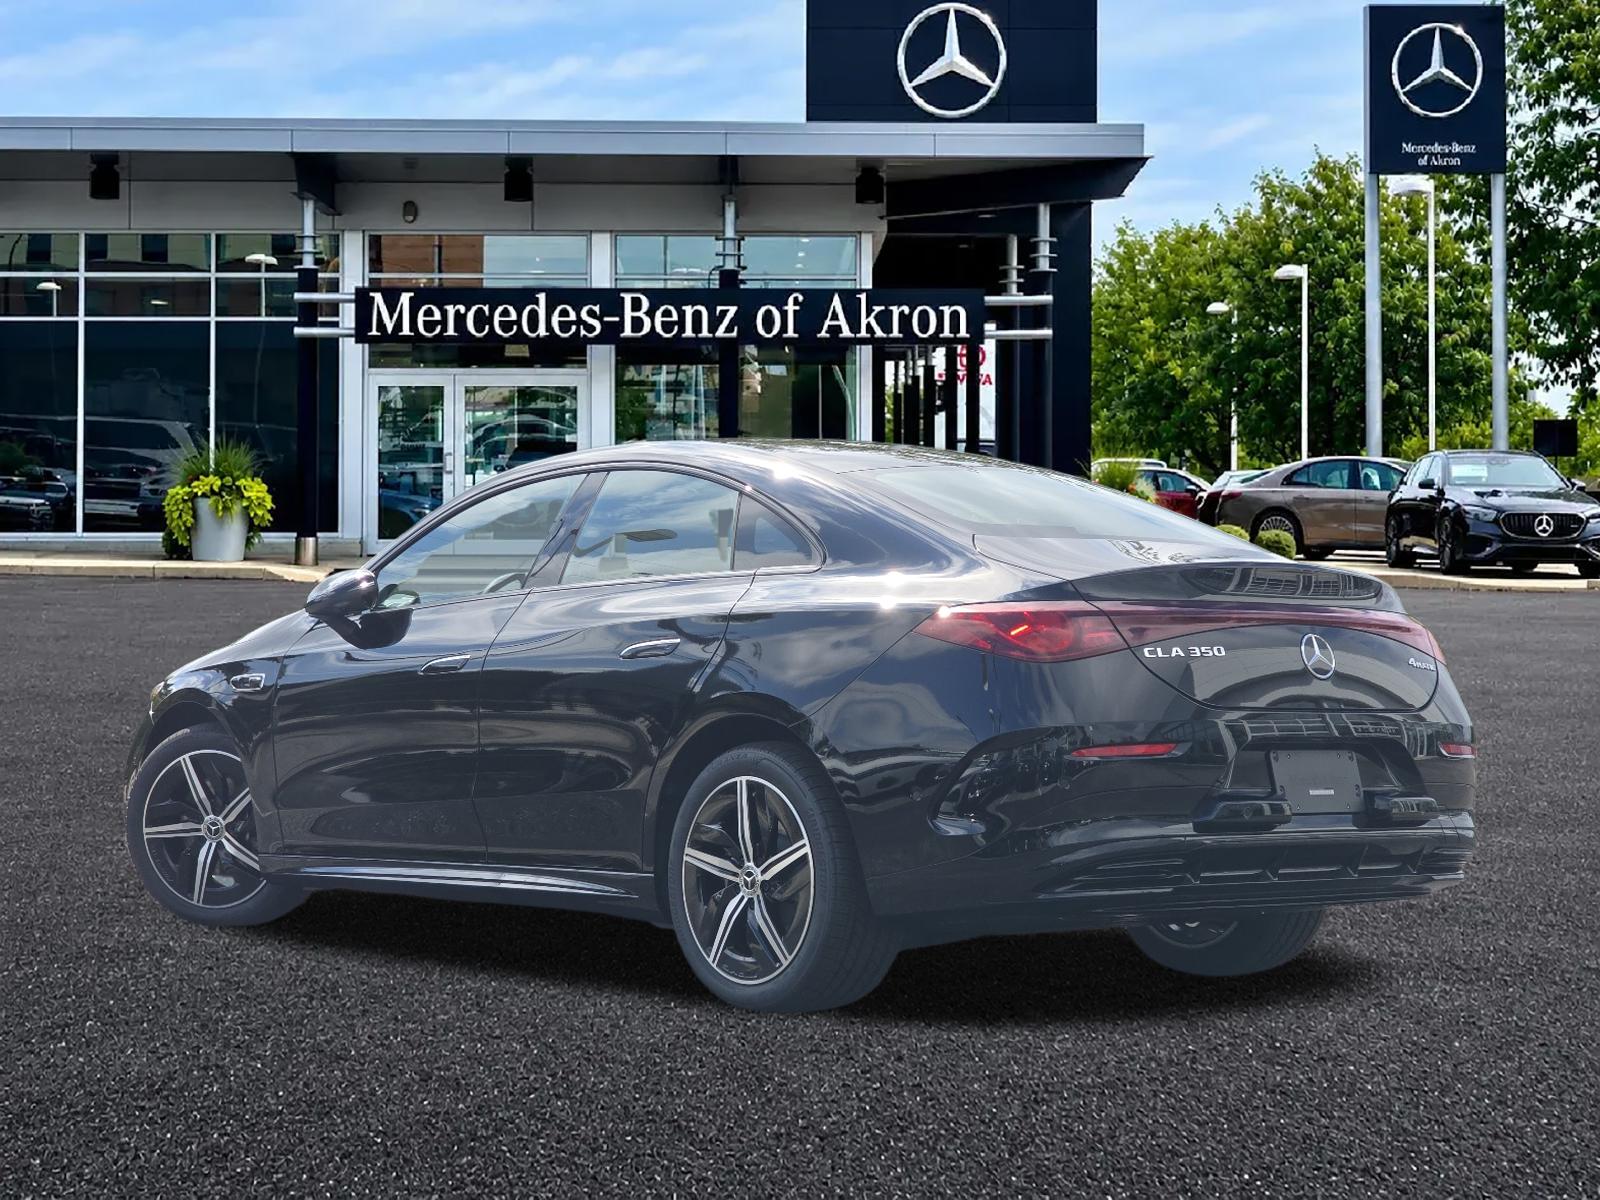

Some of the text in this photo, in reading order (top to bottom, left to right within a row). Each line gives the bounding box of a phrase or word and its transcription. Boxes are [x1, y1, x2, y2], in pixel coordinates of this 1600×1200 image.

[1401, 142, 1476, 153] Mercedes-Benz
[1418, 155, 1461, 166] of Akron
[367, 292, 970, 339] Mercedes-Benz of Akron
[1143, 646, 1226, 658] CLA 350
